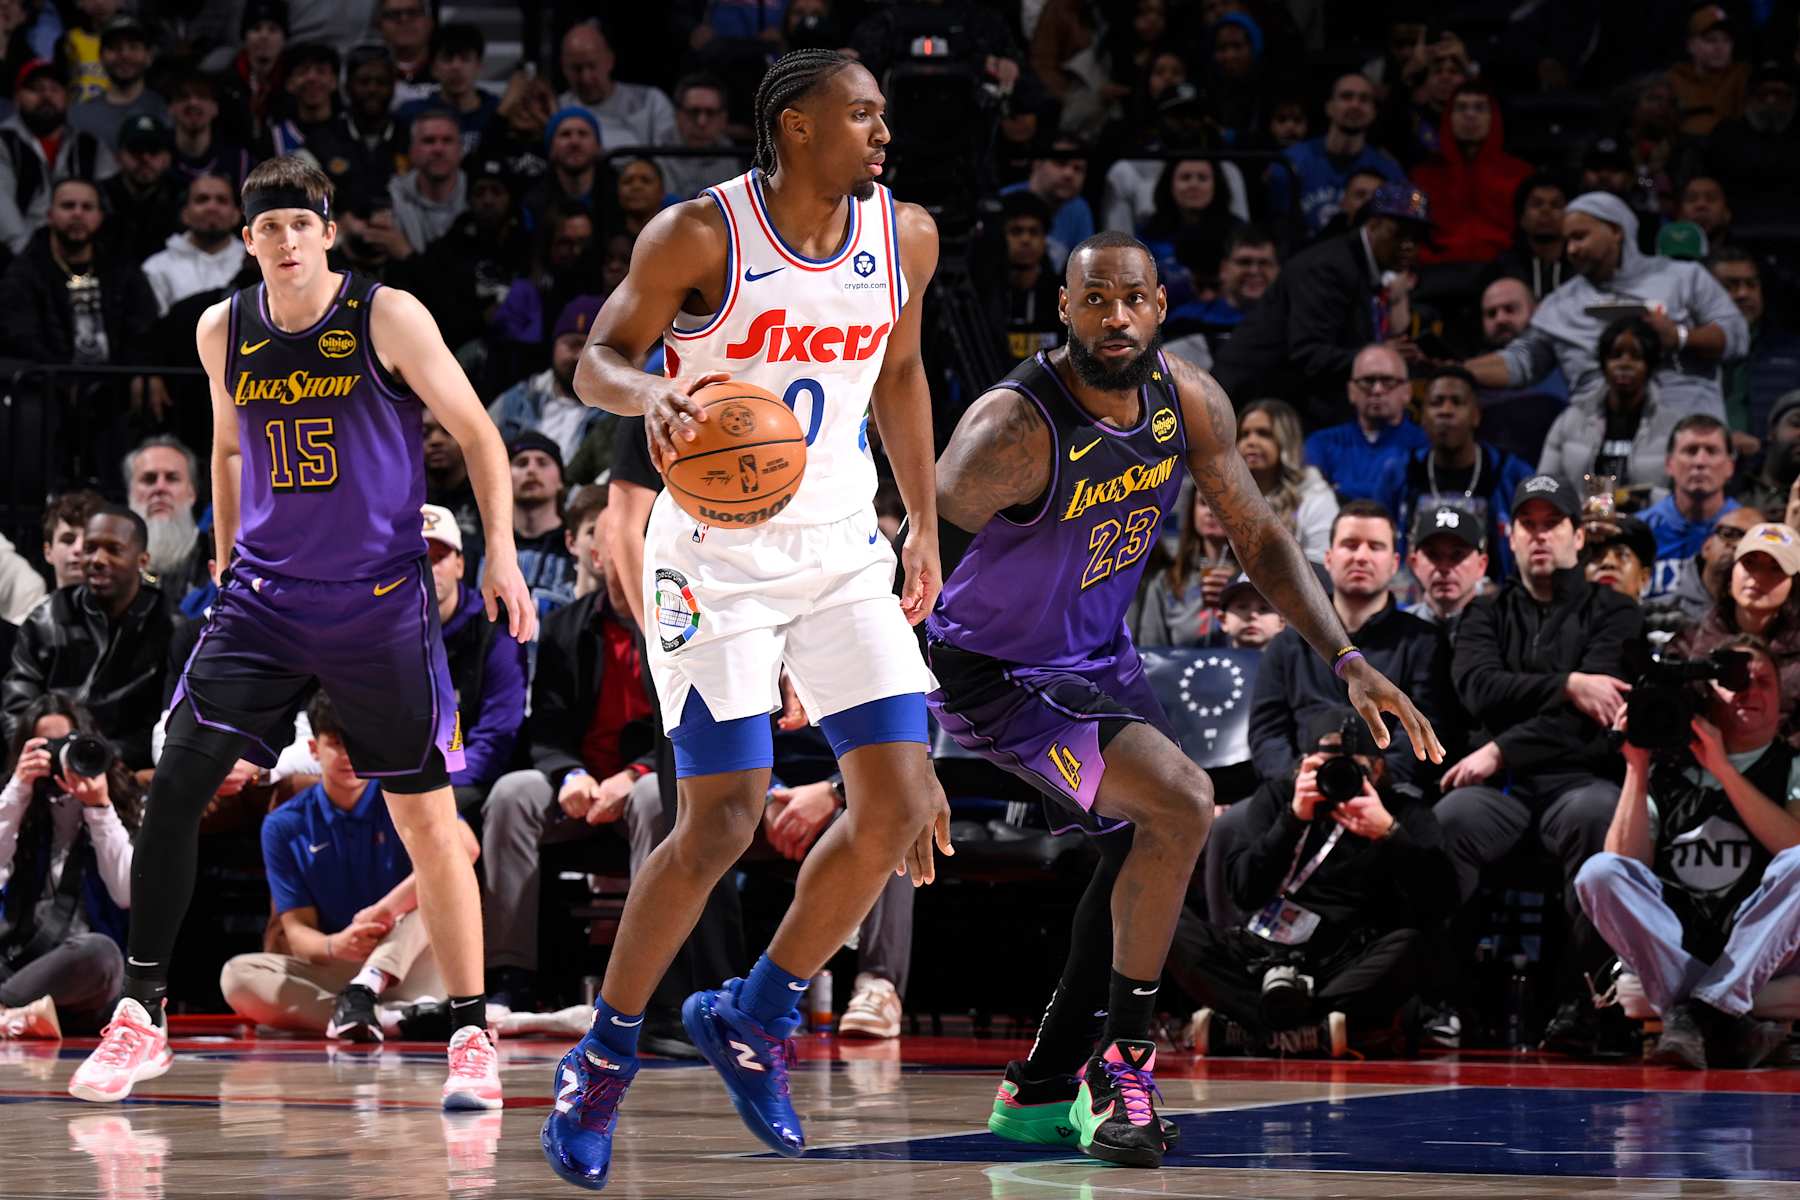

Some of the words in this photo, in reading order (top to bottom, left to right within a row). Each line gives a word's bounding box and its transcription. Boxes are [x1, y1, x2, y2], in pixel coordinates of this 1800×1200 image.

[844, 281, 888, 290] crypto.com
[322, 336, 354, 350] bibigo
[726, 309, 891, 363] Sixers
[782, 378, 825, 448] 0
[1153, 416, 1175, 433] bibigo
[265, 418, 338, 487] 15
[698, 493, 793, 525] Wilson
[1081, 505, 1161, 590] 23
[1671, 838, 1748, 868] TNT
